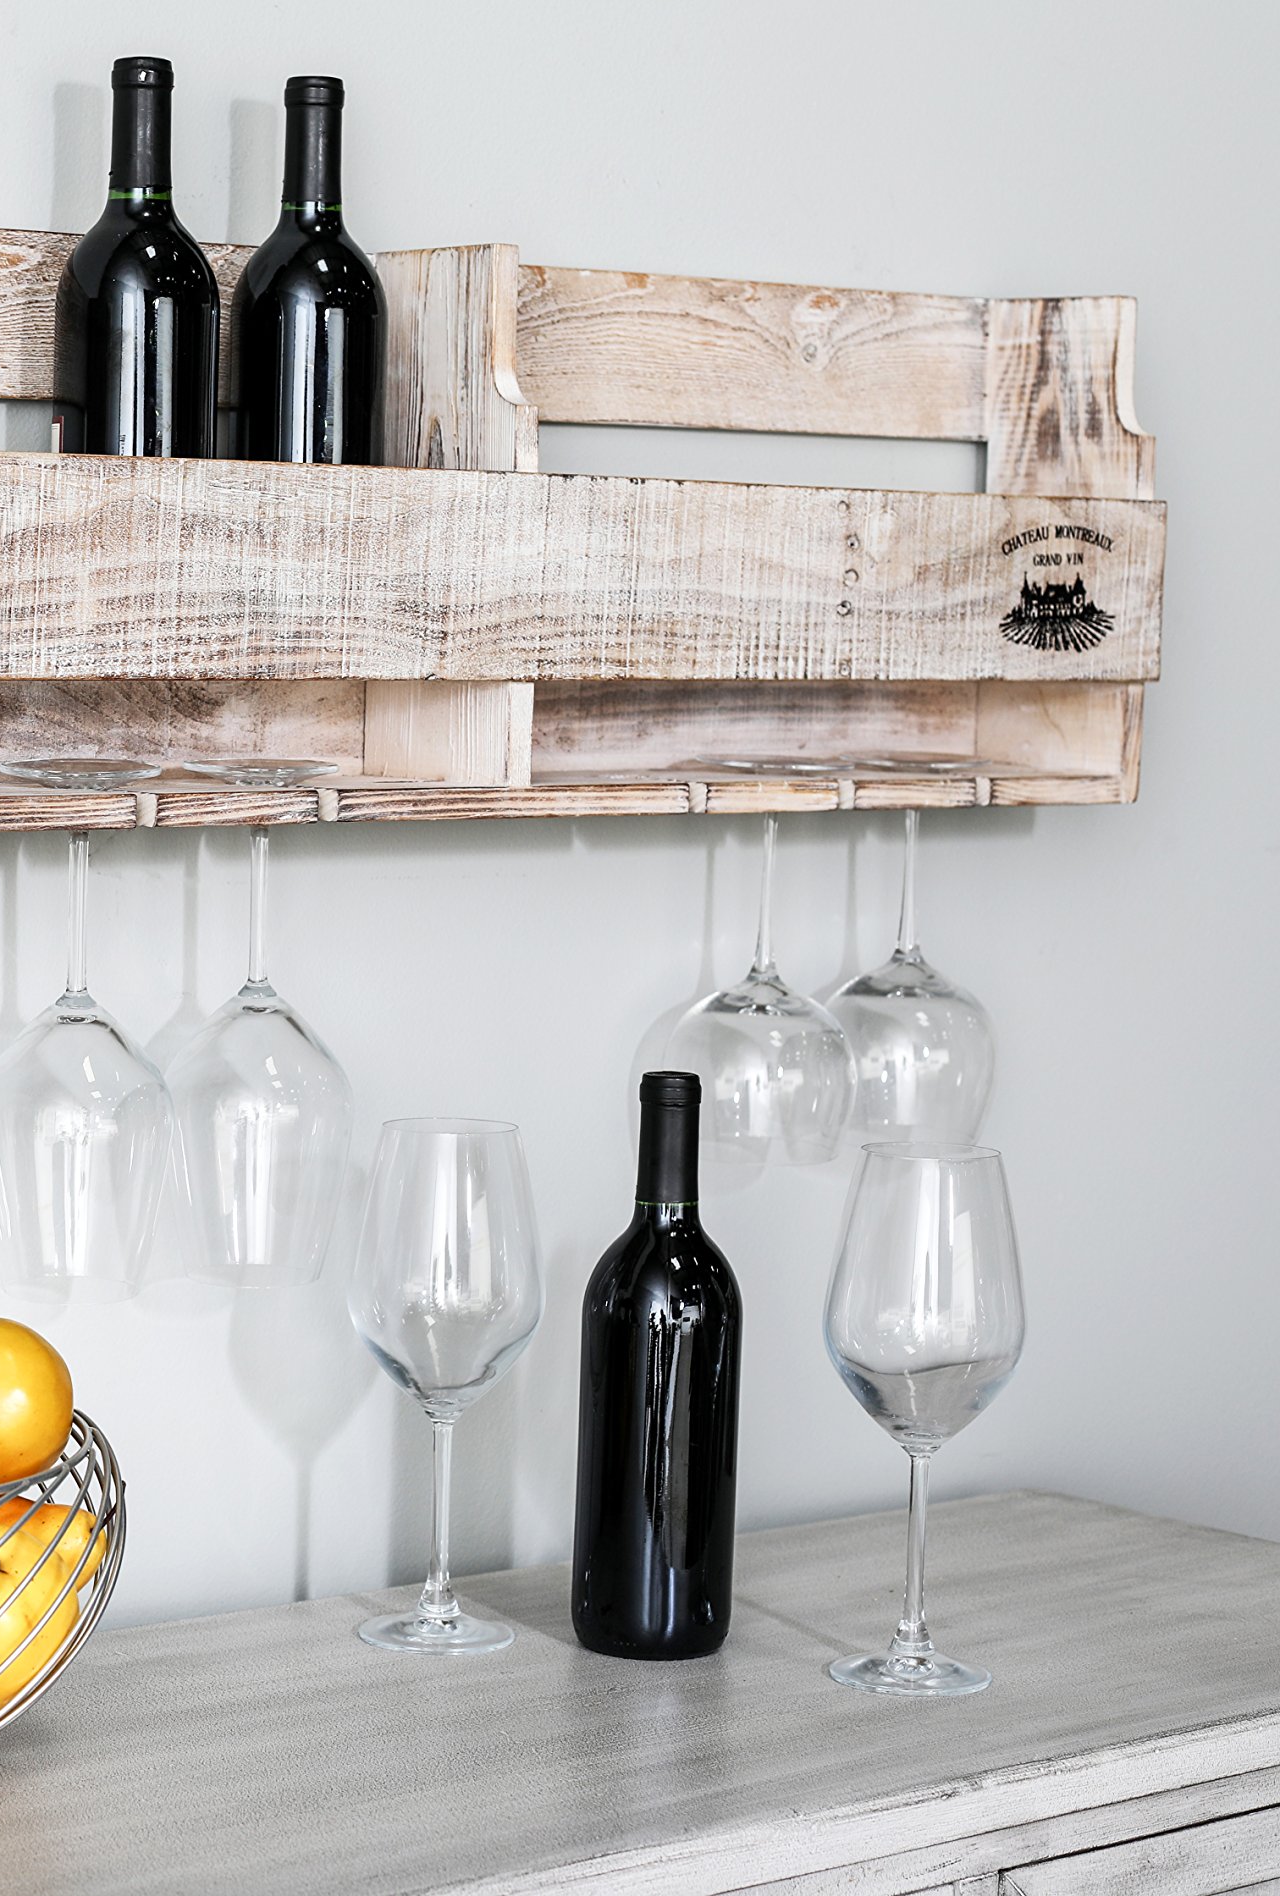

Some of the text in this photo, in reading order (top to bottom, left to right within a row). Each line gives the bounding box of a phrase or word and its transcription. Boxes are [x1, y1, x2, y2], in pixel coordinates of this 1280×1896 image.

[1001, 525, 1114, 556] CHATEAU MONTREAUX
[1032, 552, 1084, 567] GRAND VIN
